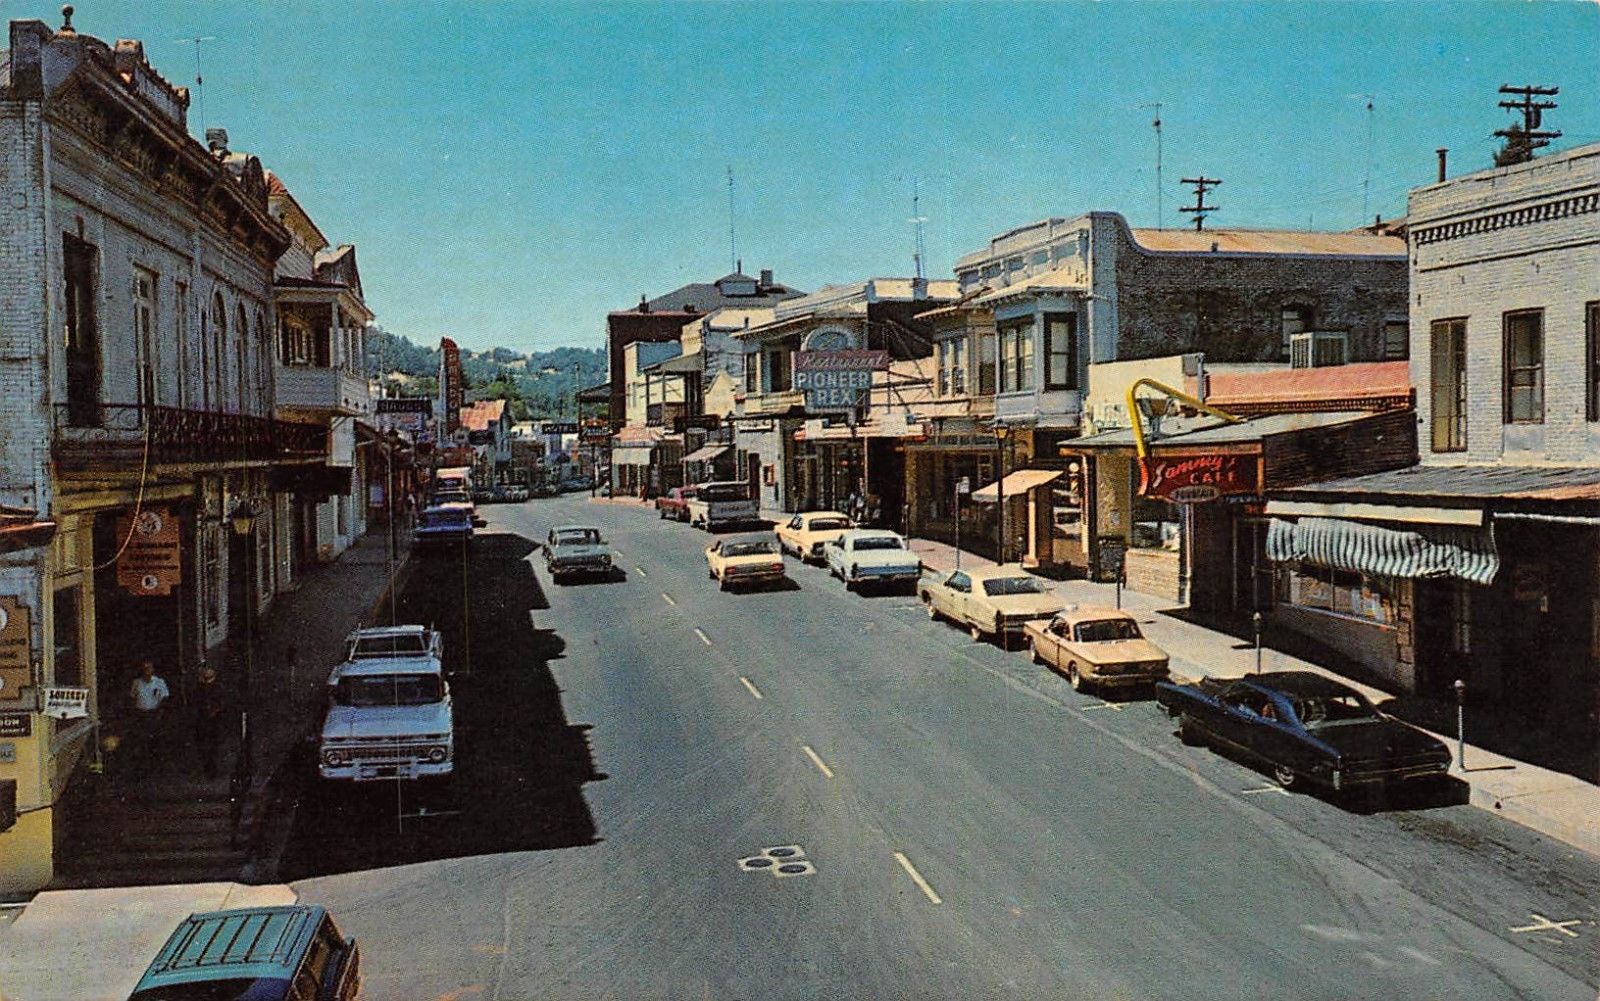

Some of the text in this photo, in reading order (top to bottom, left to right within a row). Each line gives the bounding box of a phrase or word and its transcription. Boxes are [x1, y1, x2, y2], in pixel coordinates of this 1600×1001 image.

[800, 353, 884, 369] Restaurant
[797, 371, 869, 388] PIONEER
[816, 388, 852, 405] REX
